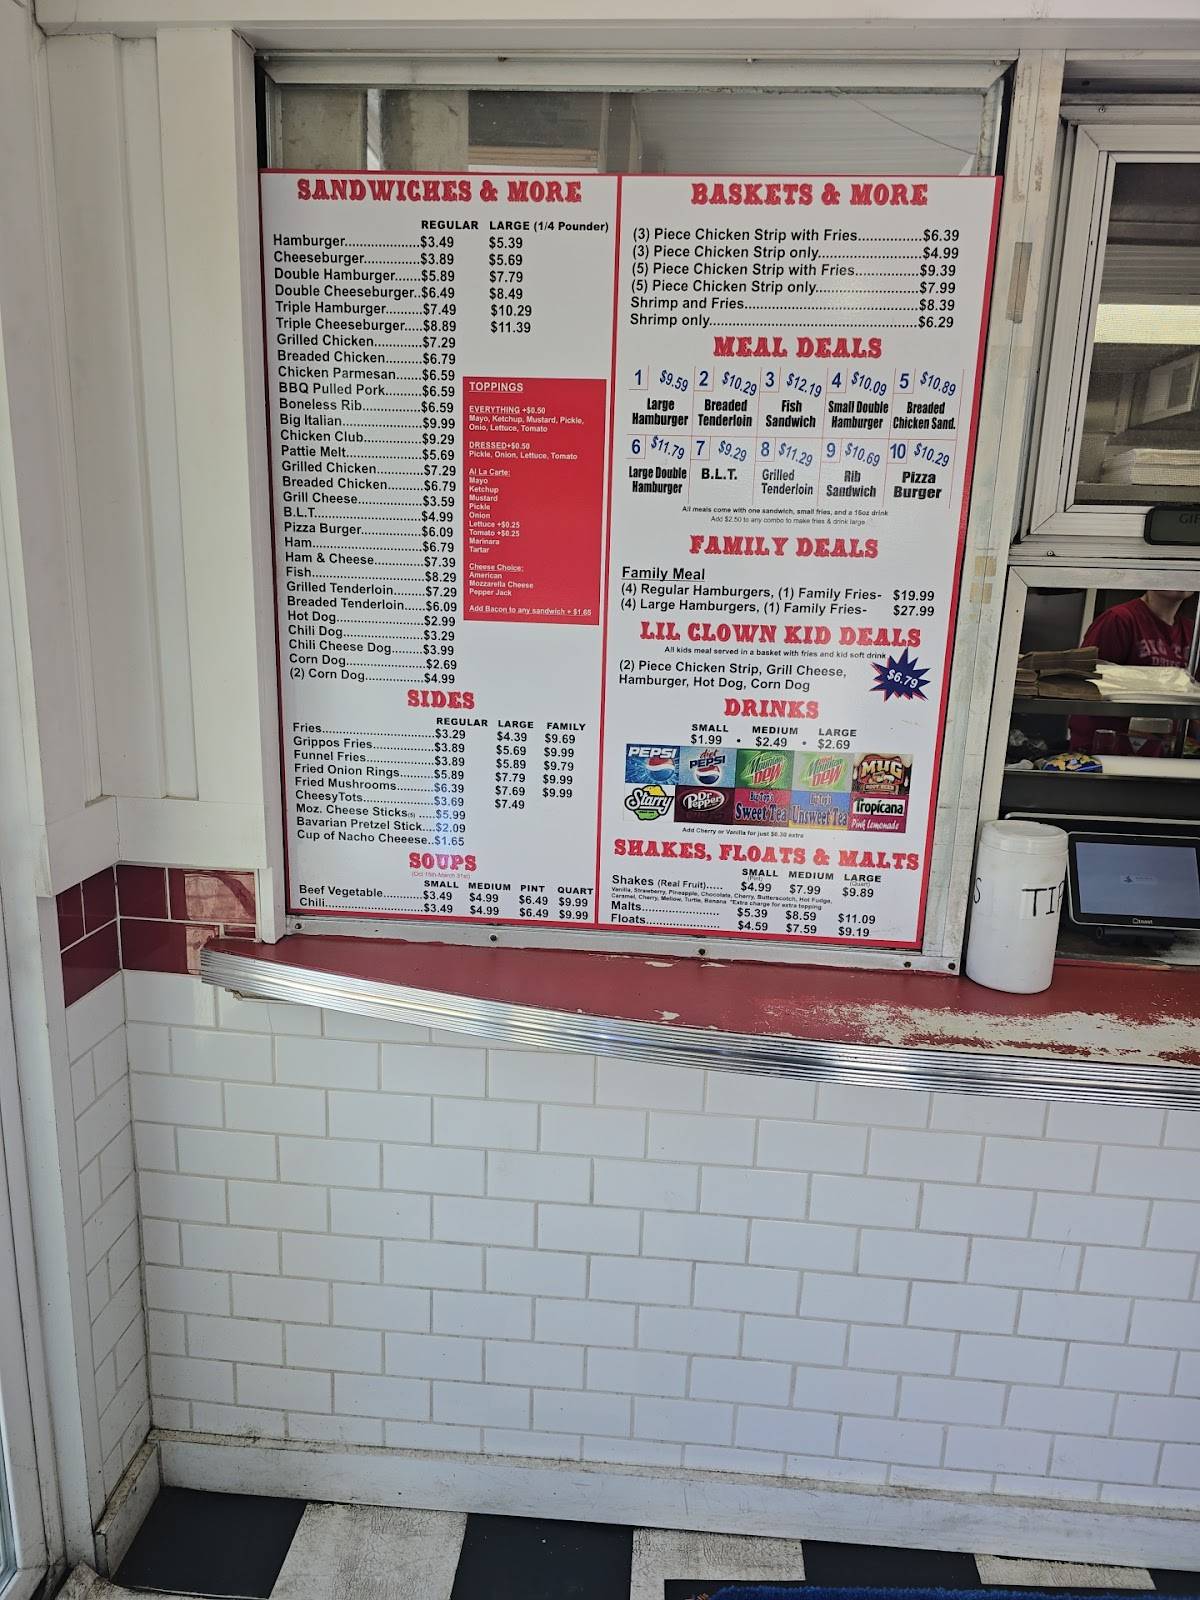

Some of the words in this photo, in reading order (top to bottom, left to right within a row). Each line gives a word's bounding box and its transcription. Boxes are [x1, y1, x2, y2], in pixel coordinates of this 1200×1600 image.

[298, 179, 472, 202] SANDWICHES
[480, 180, 498, 202] &
[507, 181, 582, 202] MORE
[691, 183, 812, 206] BASKETS
[821, 183, 840, 205] &
[850, 184, 928, 206] MORE
[421, 220, 478, 230] REGULAR
[490, 221, 530, 230] LARGE
[534, 221, 554, 232] (1/4
[558, 222, 608, 234] Pounder)
[420, 236, 454, 248] $3.49
[489, 236, 523, 249] $5.39
[633, 227, 650, 242] (3)
[655, 228, 690, 240] Piece
[695, 228, 749, 240] Chicken
[754, 228, 786, 244] Strip
[791, 229, 818, 240] with
[923, 228, 959, 242] $6.39
[420, 252, 454, 265] $3.89
[489, 253, 522, 266] $5.69
[275, 268, 319, 279] Double
[422, 269, 454, 282] $5.89
[490, 270, 523, 283] $7.79
[275, 301, 310, 315] Triple
[423, 303, 456, 316] $7.49
[491, 304, 532, 317] $10.29
[277, 333, 318, 345] Grilled
[423, 336, 456, 348] $7.29
[713, 336, 788, 357] MEAL
[796, 337, 882, 358] DEALS
[469, 382, 523, 393] TOPPINGS
[634, 369, 641, 385] 1
[660, 369, 689, 392] $9.59
[699, 370, 709, 386] 2
[722, 371, 757, 397] $10.29
[765, 372, 775, 387] 3
[787, 372, 822, 398] $12.19
[832, 372, 842, 388] 4
[851, 371, 887, 396] $10.09
[899, 373, 909, 389] 5
[920, 371, 956, 397] $10.89
[279, 382, 308, 394] BBQ
[313, 383, 352, 394] Pulled
[422, 385, 455, 398] $6.59
[469, 405, 520, 415] EVERYTHING
[704, 399, 748, 411] Breaded
[782, 400, 802, 412] Fish
[280, 414, 300, 428] Big
[423, 417, 455, 430] $9.99
[698, 414, 752, 426] Tenderloin
[766, 415, 816, 428] Sandwich
[282, 445, 316, 456] Pattie
[422, 448, 454, 461] $5.69
[902, 471, 936, 485] Pizza
[470, 486, 499, 494] Ketchup
[470, 494, 498, 502] Mustard
[893, 486, 942, 500] Burger
[689, 535, 789, 556] FAMILY
[796, 538, 878, 558] DEALS
[286, 552, 312, 562] Ham
[316, 552, 325, 563] &
[424, 556, 456, 568] $7.39
[425, 571, 456, 582] $8.29
[622, 566, 668, 581] Family
[673, 567, 705, 580] Meal
[469, 580, 506, 588] Mozzarella
[507, 581, 534, 589] Cheese
[470, 588, 495, 597] Pepper
[622, 583, 636, 596] (4)
[641, 584, 690, 597] Regular
[693, 585, 774, 599] Hamburgers,
[778, 586, 794, 600] (1)
[799, 588, 840, 601] Family
[893, 590, 934, 601] $19.99
[640, 621, 680, 640] LIL
[688, 623, 777, 643] CLOWN
[784, 626, 831, 644] KID
[839, 627, 920, 647] DEALS
[887, 669, 919, 689] $6.79
[408, 690, 474, 709] SIDES
[724, 698, 818, 719] DRINKS
[436, 718, 488, 727] REGULAR
[498, 720, 534, 728] LARGE
[546, 722, 586, 731] FAMILY
[692, 724, 728, 732] SMALL
[752, 726, 798, 735] MEDIUM
[818, 728, 856, 737] LARGE
[435, 728, 465, 739] $3.29
[497, 731, 527, 742] $4.39
[545, 733, 575, 744] $9.69
[691, 734, 722, 744] $1.99
[756, 736, 787, 747] $2.49
[818, 739, 850, 750] $2.69
[628, 746, 676, 758] PEPSI
[700, 749, 717, 759] diet
[689, 756, 725, 769] PEPSI
[861, 760, 903, 779] MUG
[434, 796, 464, 806] $3.69
[495, 799, 524, 809] $7.49
[625, 788, 674, 815] Starry
[688, 795, 723, 810] Pepper
[698, 792, 712, 801] Dr
[735, 802, 768, 822] Sweet
[769, 806, 787, 822] Tea
[855, 799, 903, 815] Tropicana
[409, 852, 476, 872] SOUPS
[614, 838, 712, 861] SHAKES,
[719, 844, 806, 864] FLOATS
[813, 848, 830, 865] &
[838, 850, 918, 870] MALTS
[424, 880, 459, 888] SMALL
[468, 882, 510, 891] MEDIUM
[520, 884, 545, 892] PINT
[558, 886, 593, 894] QUART
[424, 903, 453, 913] $3.49
[470, 905, 499, 915] $4.99
[520, 908, 548, 918] $6.49
[559, 910, 588, 920] $9.99
[737, 907, 768, 918] $5.39
[786, 910, 816, 921] $8.59
[838, 913, 875, 924] $11.09
